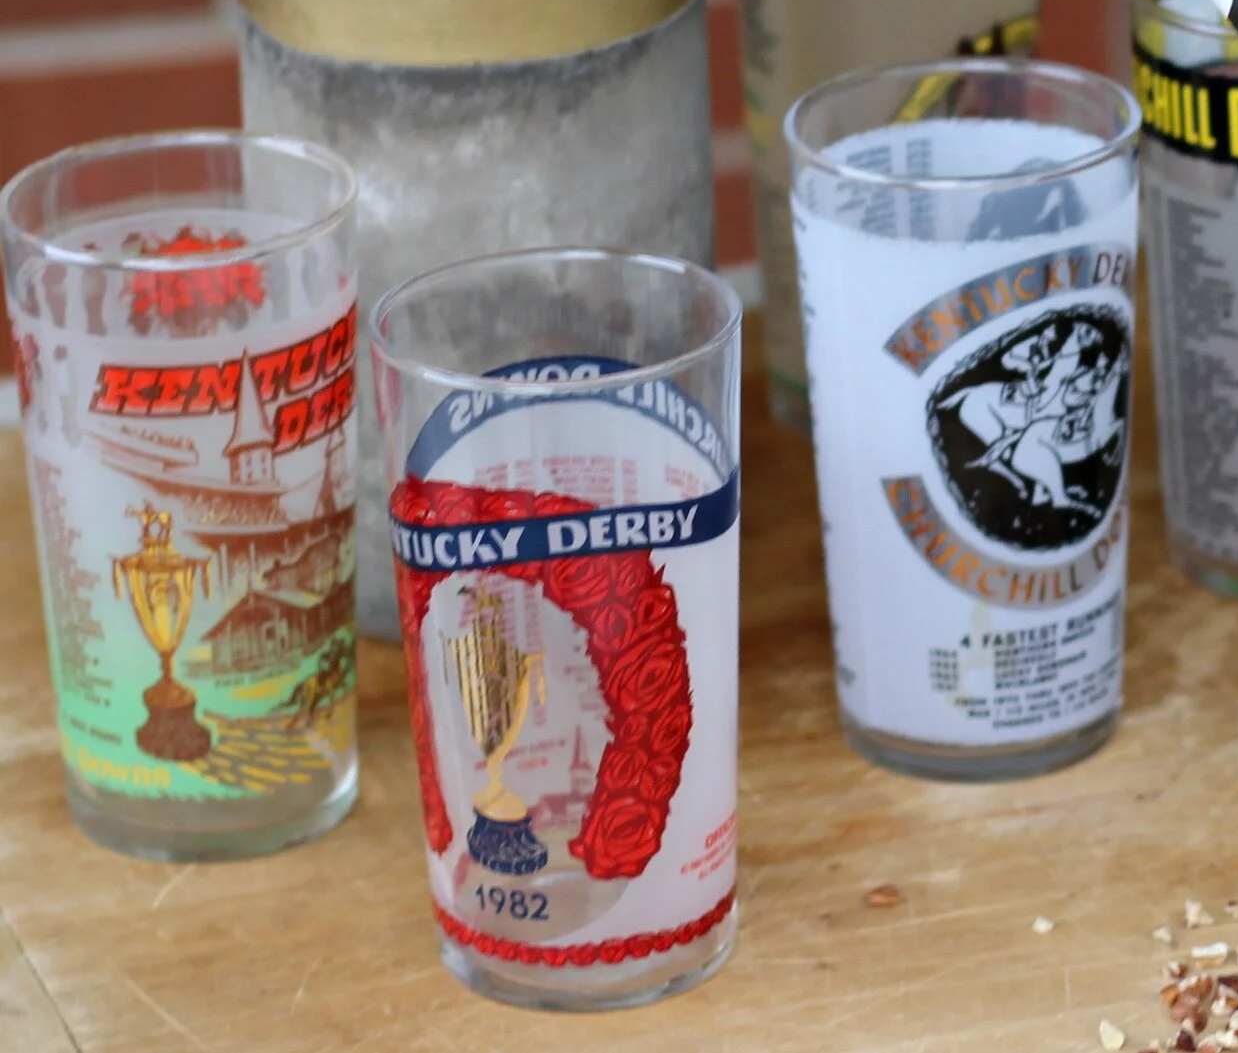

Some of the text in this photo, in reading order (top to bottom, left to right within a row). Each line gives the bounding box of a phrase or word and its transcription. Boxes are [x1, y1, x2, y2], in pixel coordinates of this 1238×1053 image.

[1134, 60, 1217, 150] CHILL
[891, 254, 1083, 372] KENTUCKY
[89, 303, 358, 417] KENTUC
[271, 365, 358, 457] DER
[393, 504, 700, 568] TUCKY DERBY
[888, 479, 1083, 604] CHURCHILL
[474, 883, 550, 922] 1982
